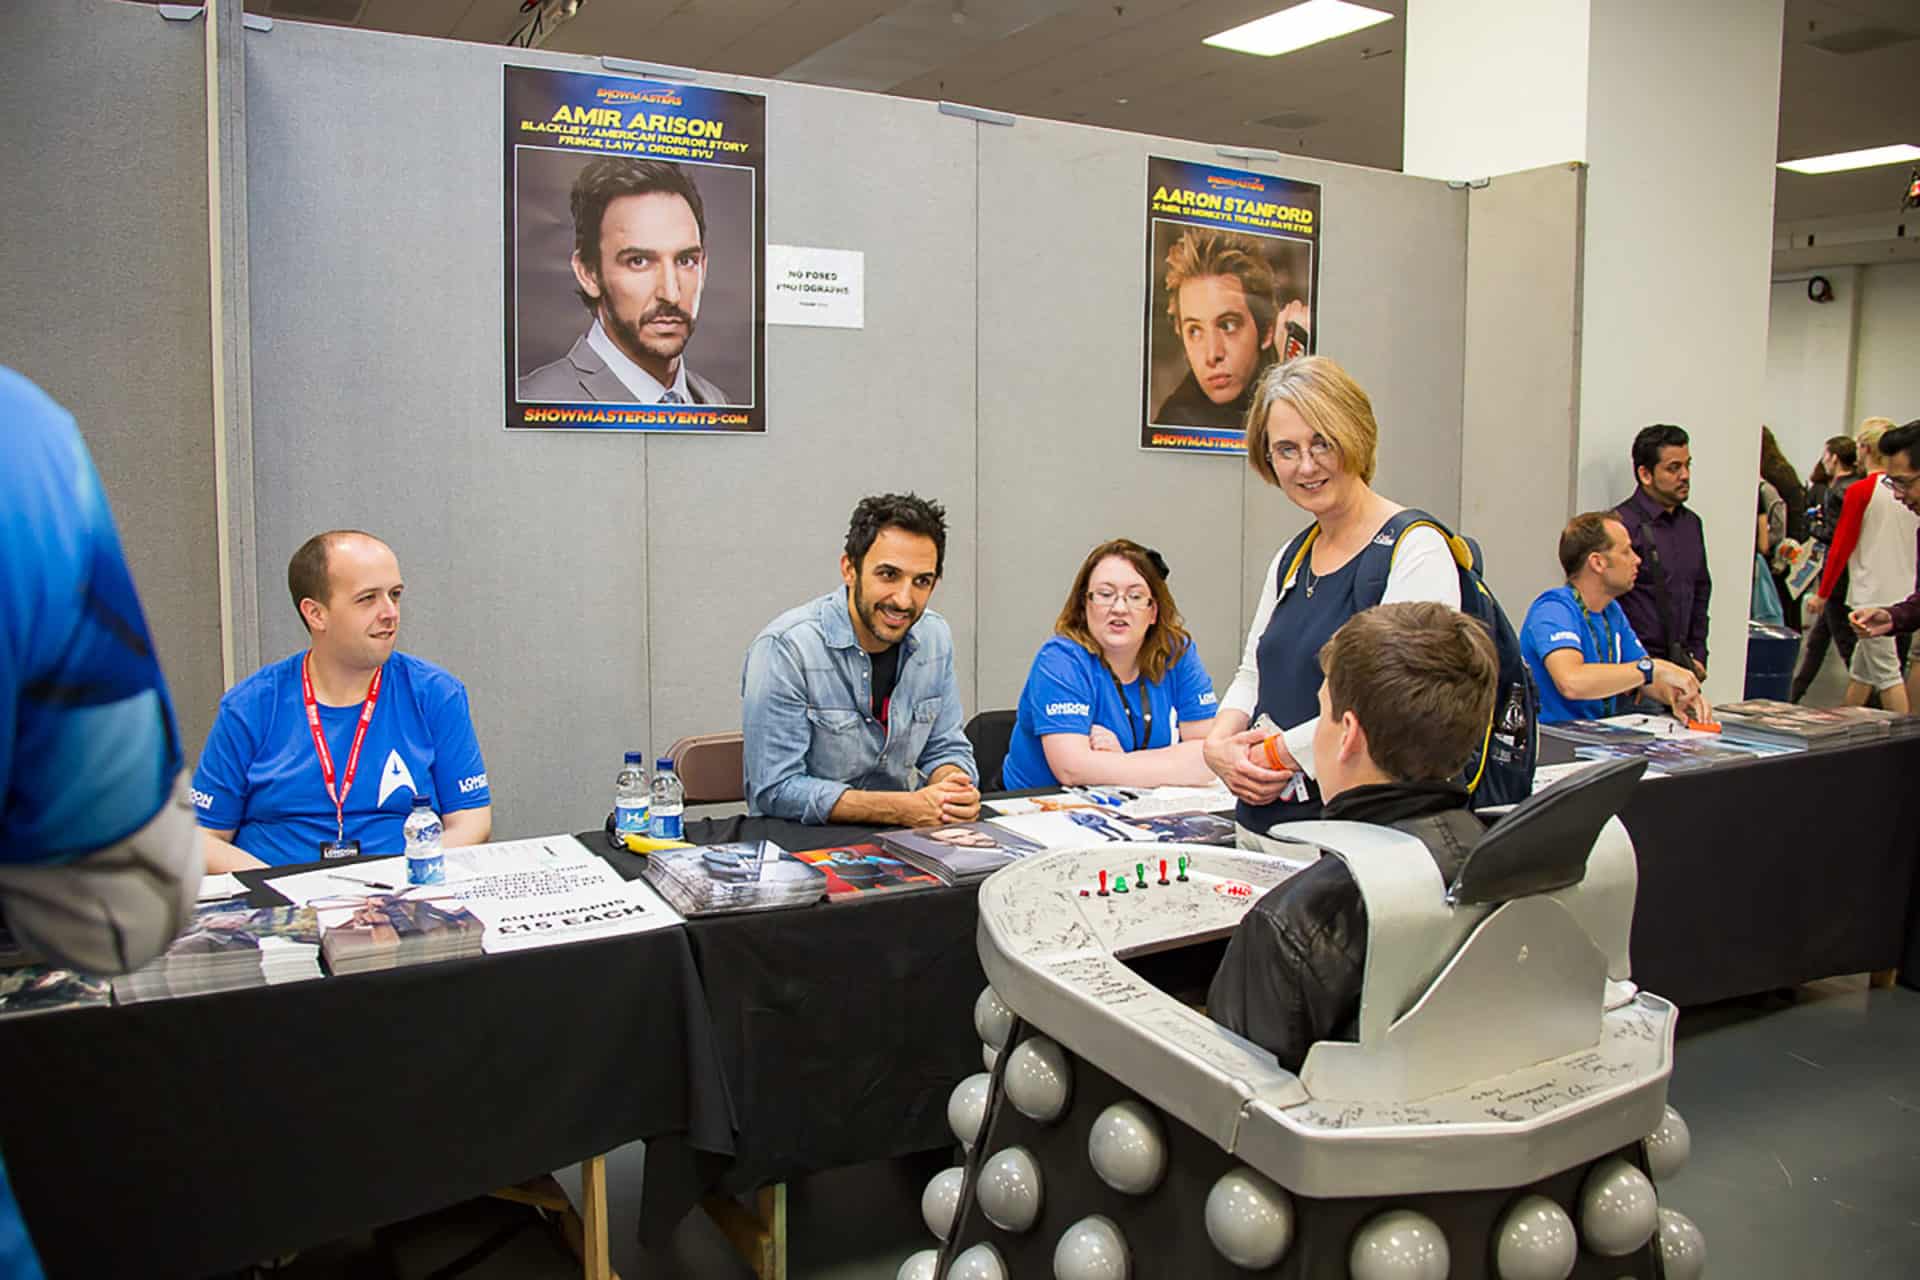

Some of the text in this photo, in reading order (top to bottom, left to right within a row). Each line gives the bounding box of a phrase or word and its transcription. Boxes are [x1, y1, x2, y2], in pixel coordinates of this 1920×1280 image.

[597, 88, 682, 106] SHOWMASTERS
[552, 105, 723, 139] AMIR ARISON
[520, 120, 750, 153] BLACKLIST, AMERICAN HORROR STORY
[605, 138, 636, 151] LAW
[636, 143, 646, 152] &
[1153, 186, 1314, 225] AARON STANFORD
[788, 270, 838, 281] NO POSED
[1046, 702, 1091, 717] LONDON
[500, 900, 626, 922] AUTOGRAPHS
[562, 905, 646, 926] EACH
